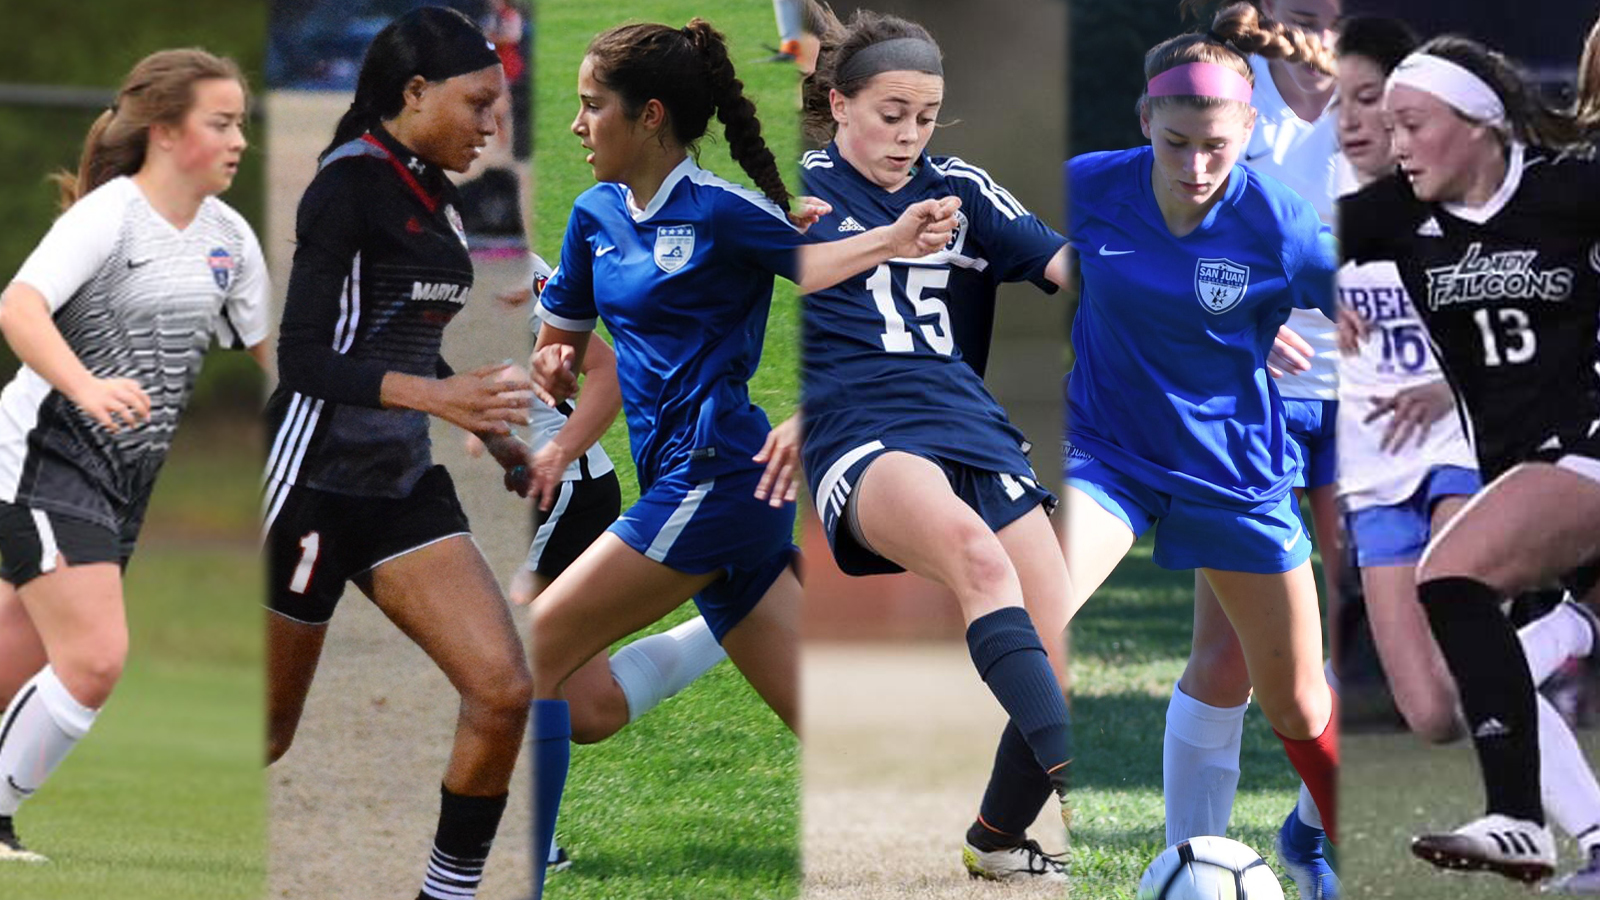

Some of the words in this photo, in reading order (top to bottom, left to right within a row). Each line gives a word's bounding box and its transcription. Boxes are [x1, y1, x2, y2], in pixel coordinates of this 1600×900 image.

[1199, 267, 1219, 278] SAN
[1220, 272, 1245, 283] JUAN
[1425, 265, 1574, 311] FALCONS
[866, 264, 954, 356] 15
[1474, 308, 1536, 366] 13
[290, 531, 320, 594] 1
